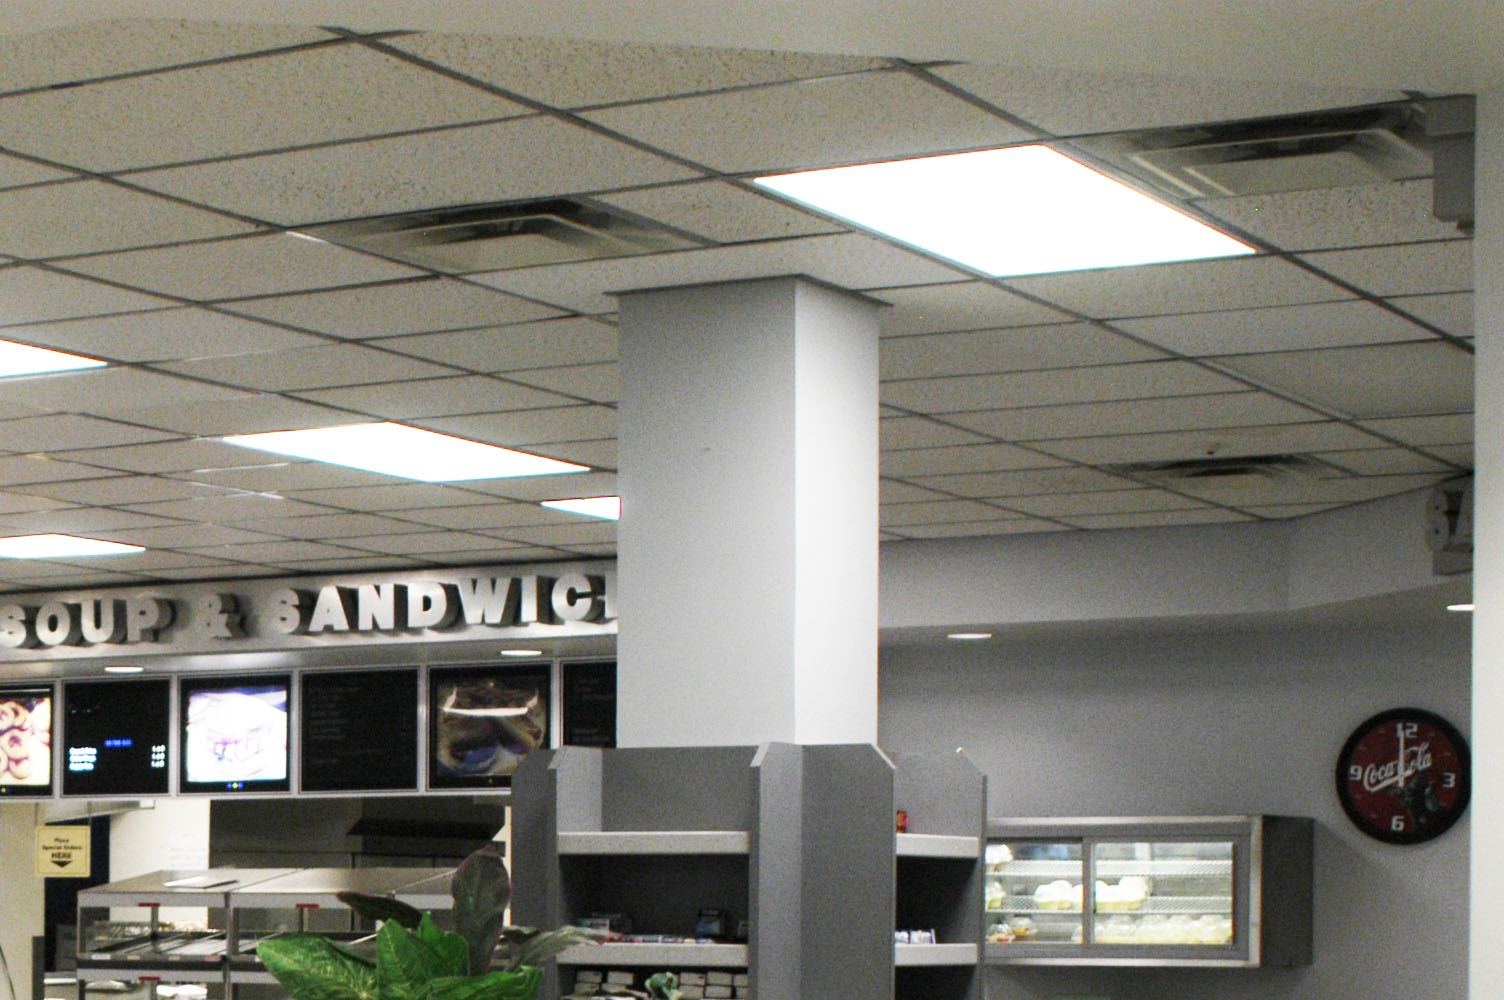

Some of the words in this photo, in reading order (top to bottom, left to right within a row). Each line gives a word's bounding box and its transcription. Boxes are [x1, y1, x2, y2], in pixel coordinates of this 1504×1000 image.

[197, 592, 234, 639] &
[1396, 722, 1418, 739] 12
[1442, 772, 1456, 788] 3
[1390, 815, 1405, 831] 6
